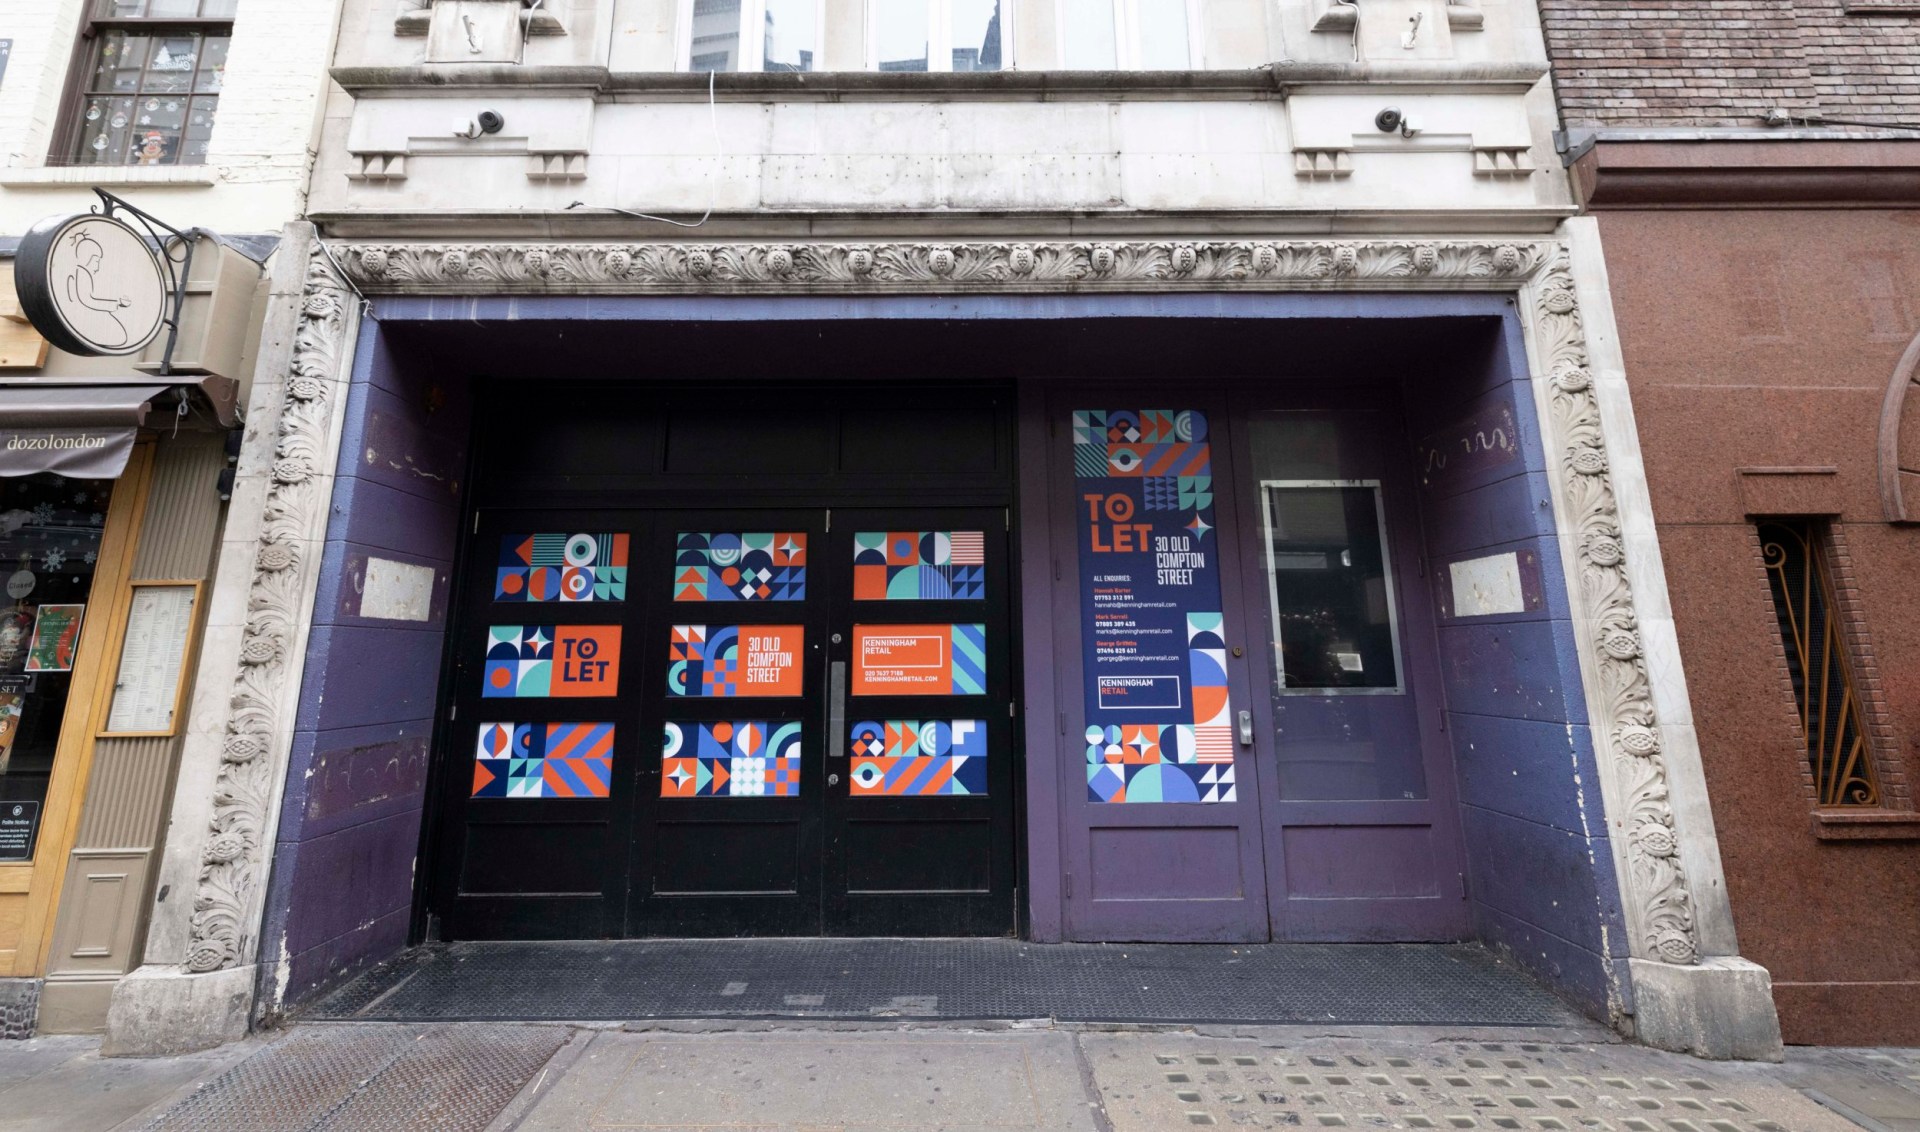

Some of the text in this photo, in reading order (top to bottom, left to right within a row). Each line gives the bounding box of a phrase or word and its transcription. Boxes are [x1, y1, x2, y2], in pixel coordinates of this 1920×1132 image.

[7, 433, 106, 450] dozolondon
[1084, 493, 1134, 522] TO
[1091, 524, 1153, 552] LET
[1155, 536, 1190, 552] 30 OLD
[1156, 552, 1205, 568] COMPTON
[9, 580, 33, 590] Closed
[1157, 569, 1193, 585] STREET
[562, 638, 599, 659] TO
[748, 636, 780, 652] 30 OLD
[865, 639, 917, 647] KENNINGHAM
[865, 647, 892, 655] RETAIL
[1096, 640, 1114, 648] George
[747, 652, 792, 667] COMPTON
[563, 661, 610, 682] LET
[747, 667, 781, 683] STREET
[1, 685, 18, 694] SET
[1101, 679, 1154, 687] KENNINGHAM
